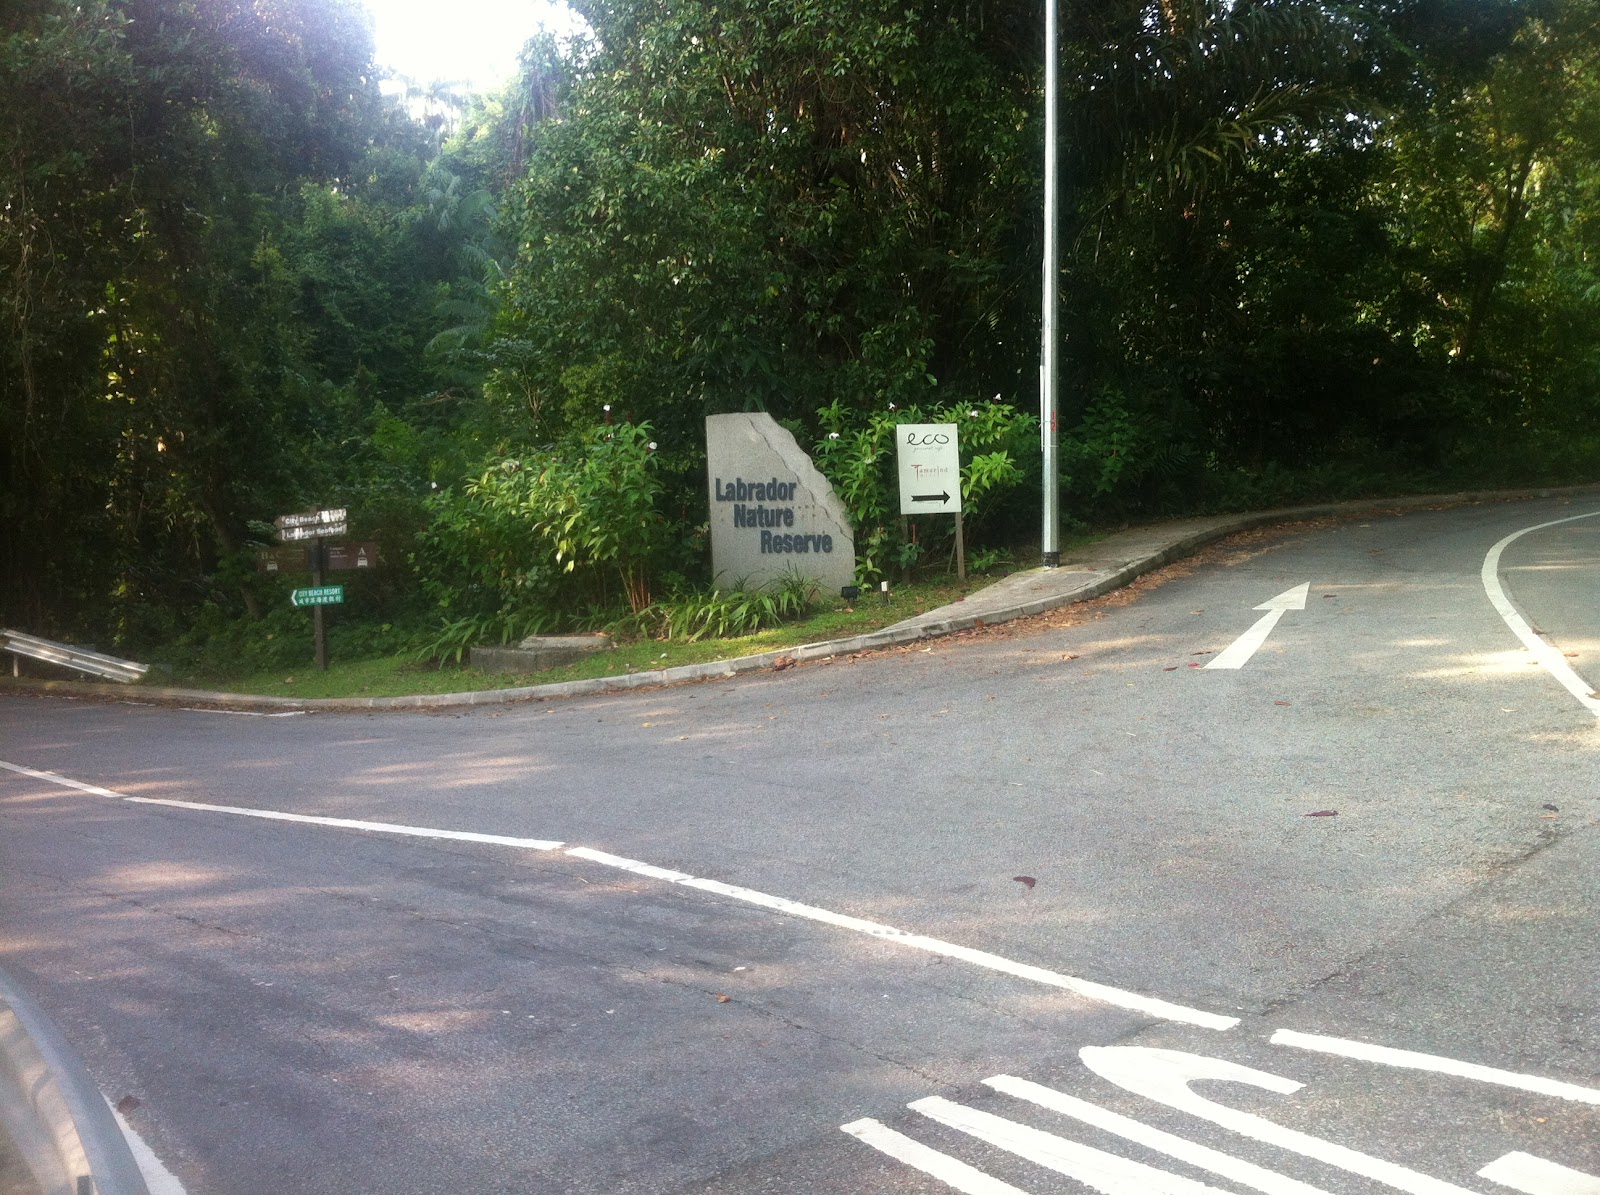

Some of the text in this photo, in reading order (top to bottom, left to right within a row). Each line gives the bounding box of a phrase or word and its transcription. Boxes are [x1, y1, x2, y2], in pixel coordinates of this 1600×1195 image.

[907, 432, 949, 446] eco
[715, 477, 797, 502] Labrador
[285, 516, 299, 526] City
[299, 515, 320, 523] Beach
[733, 503, 794, 528] Nature
[760, 530, 833, 554] Reserve
[308, 589, 323, 597] BEACH
[323, 587, 340, 596] RESORT
